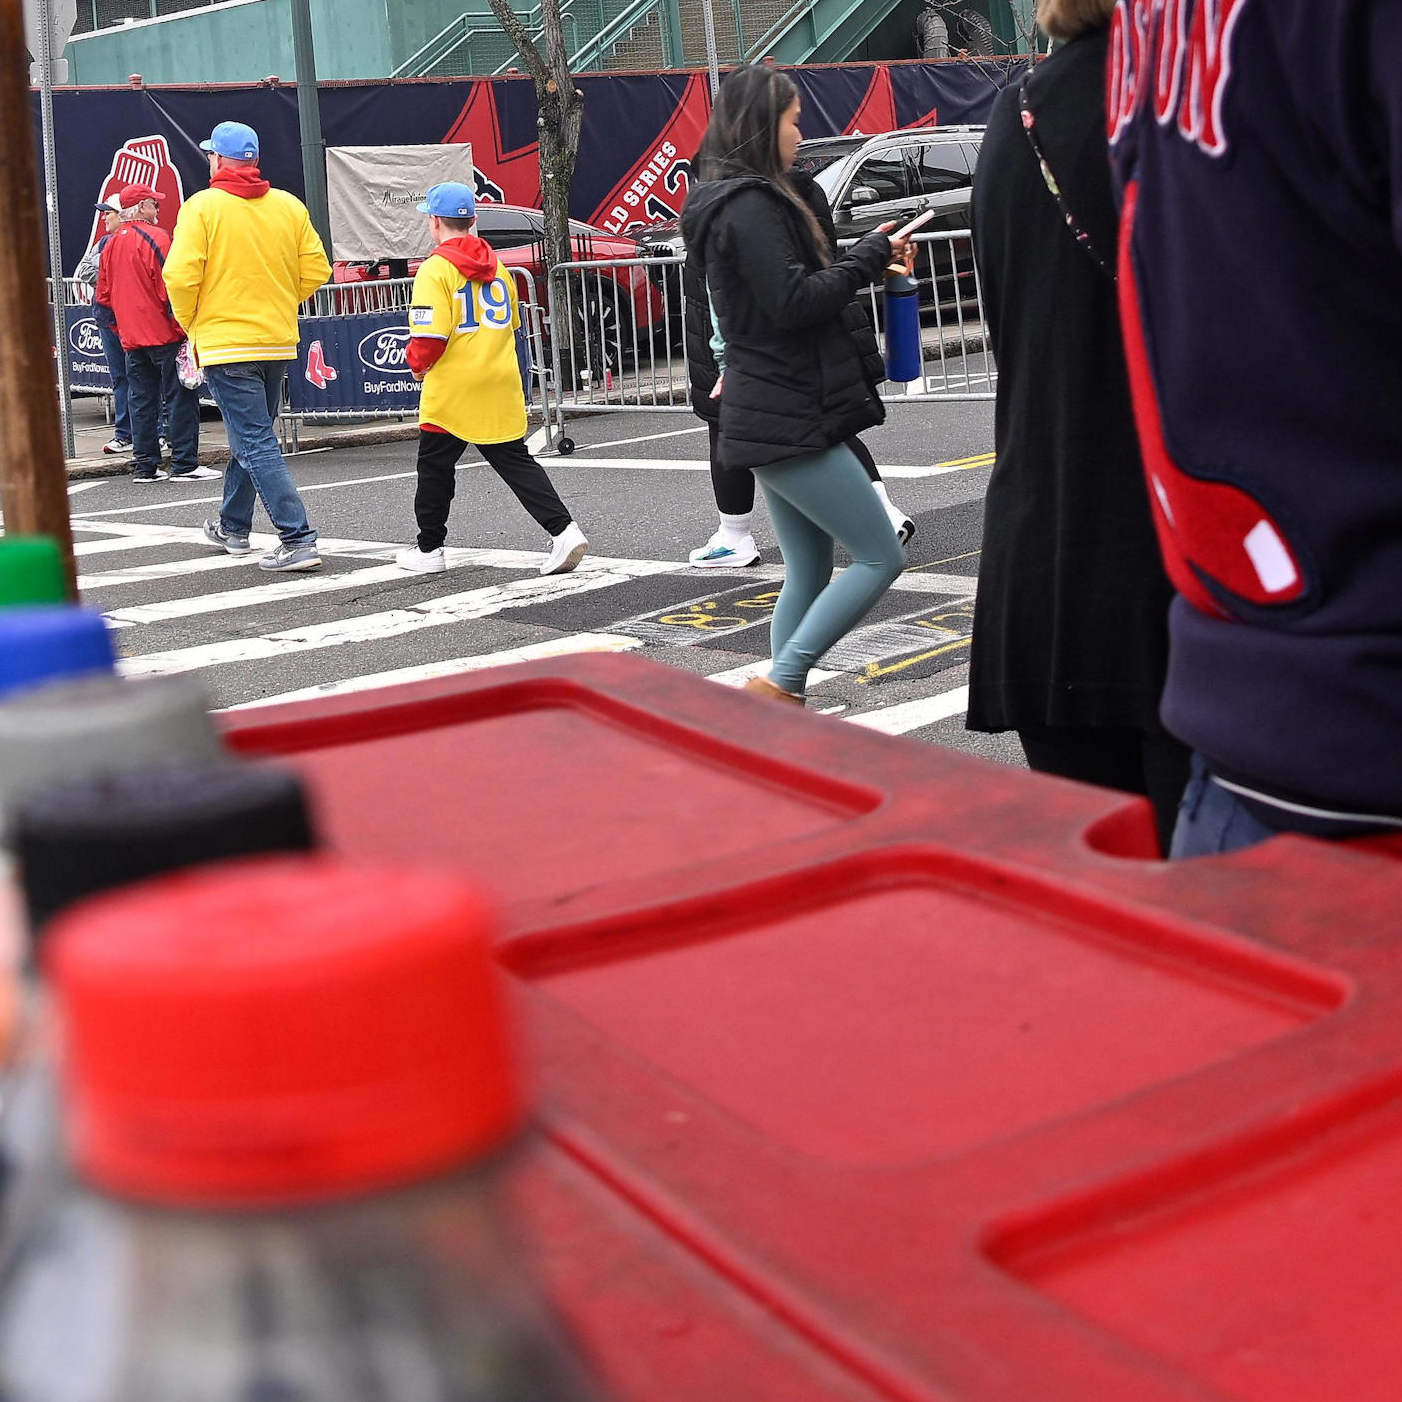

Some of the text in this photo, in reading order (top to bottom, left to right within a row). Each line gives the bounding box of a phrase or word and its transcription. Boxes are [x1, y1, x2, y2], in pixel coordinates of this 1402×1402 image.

[622, 141, 678, 207] SERIES
[414, 310, 426, 320] 617
[453, 277, 513, 335] 19
